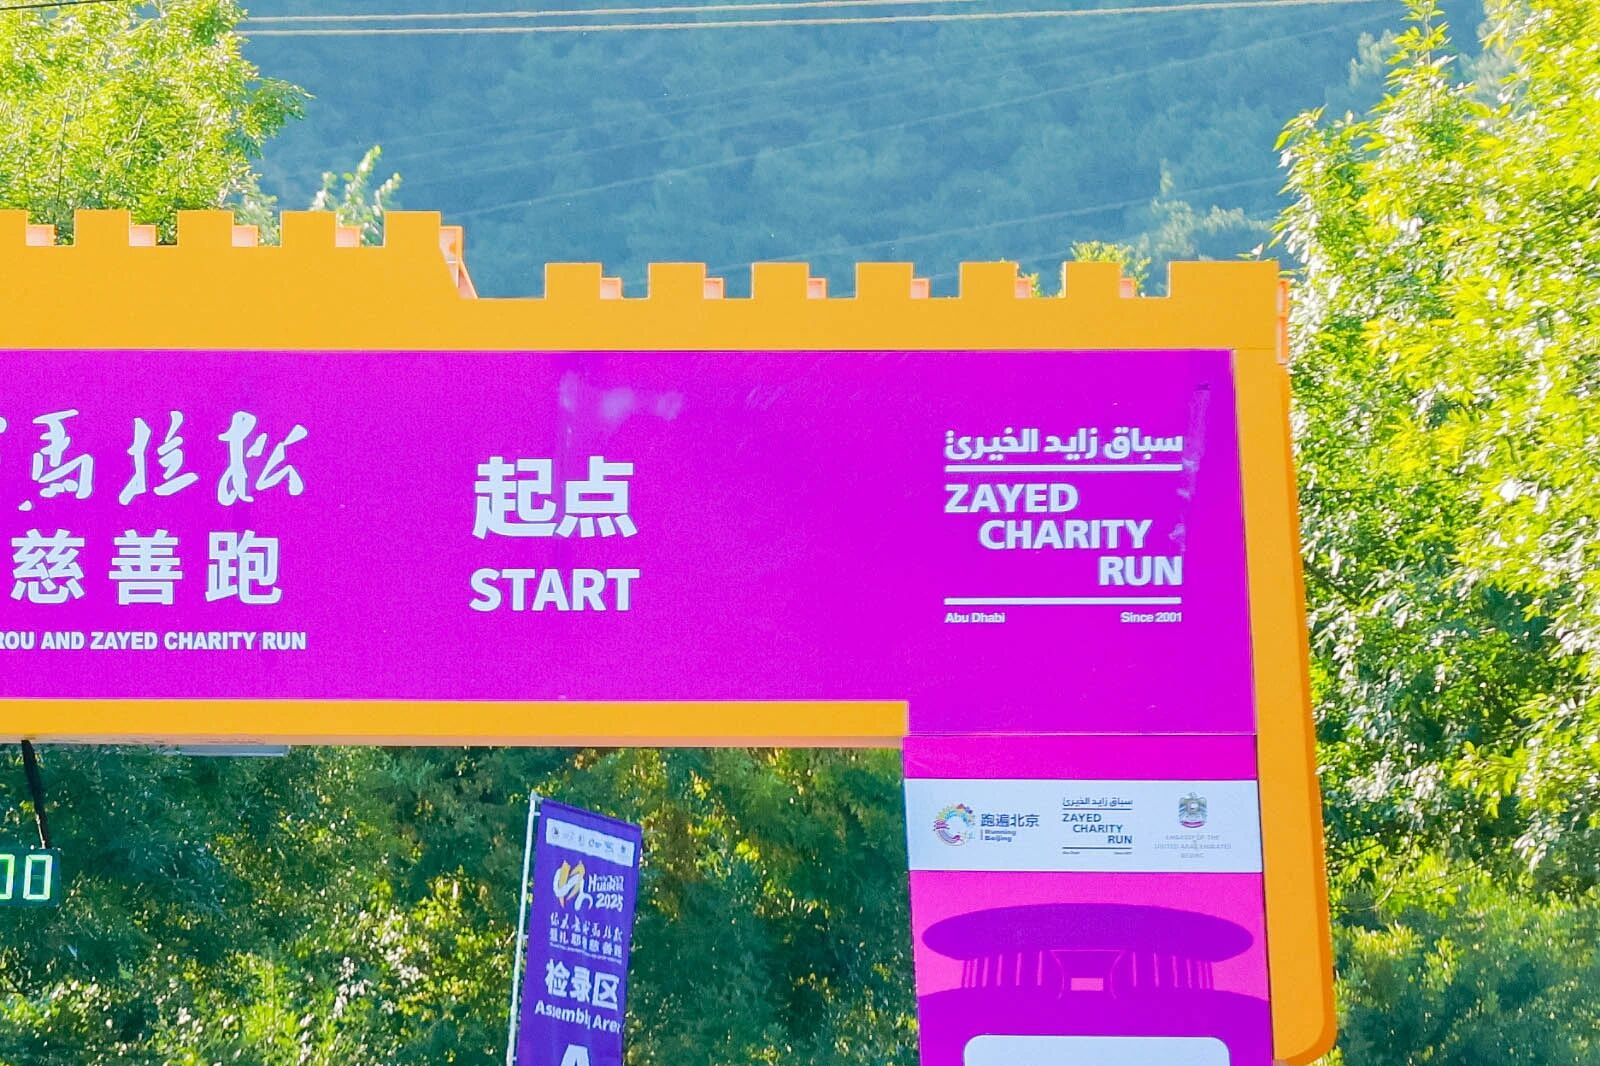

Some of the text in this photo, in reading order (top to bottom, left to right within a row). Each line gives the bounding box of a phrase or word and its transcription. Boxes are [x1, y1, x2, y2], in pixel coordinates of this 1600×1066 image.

[1044, 428, 1098, 460] زايد
[1104, 427, 1183, 459] سباق
[473, 456, 638, 539] 起点
[944, 483, 1078, 513] ZAYED
[979, 519, 1153, 549] CHARITY
[1099, 556, 1183, 586] RUN
[469, 568, 640, 612] START
[945, 612, 1005, 622] Abu Dhabi
[1121, 611, 1182, 622] Since 2001
[41, 630, 84, 650] AND
[91, 630, 158, 650] ZAYED
[164, 630, 256, 650] CHARITY
[263, 630, 306, 650] RUN
[981, 813, 1040, 828] 跑遍北京
[1062, 813, 1102, 822] ZAYED
[1073, 824, 1123, 833] CHARITY
[1108, 835, 1133, 844] RUN
[545, 958, 619, 1011] 检录区
